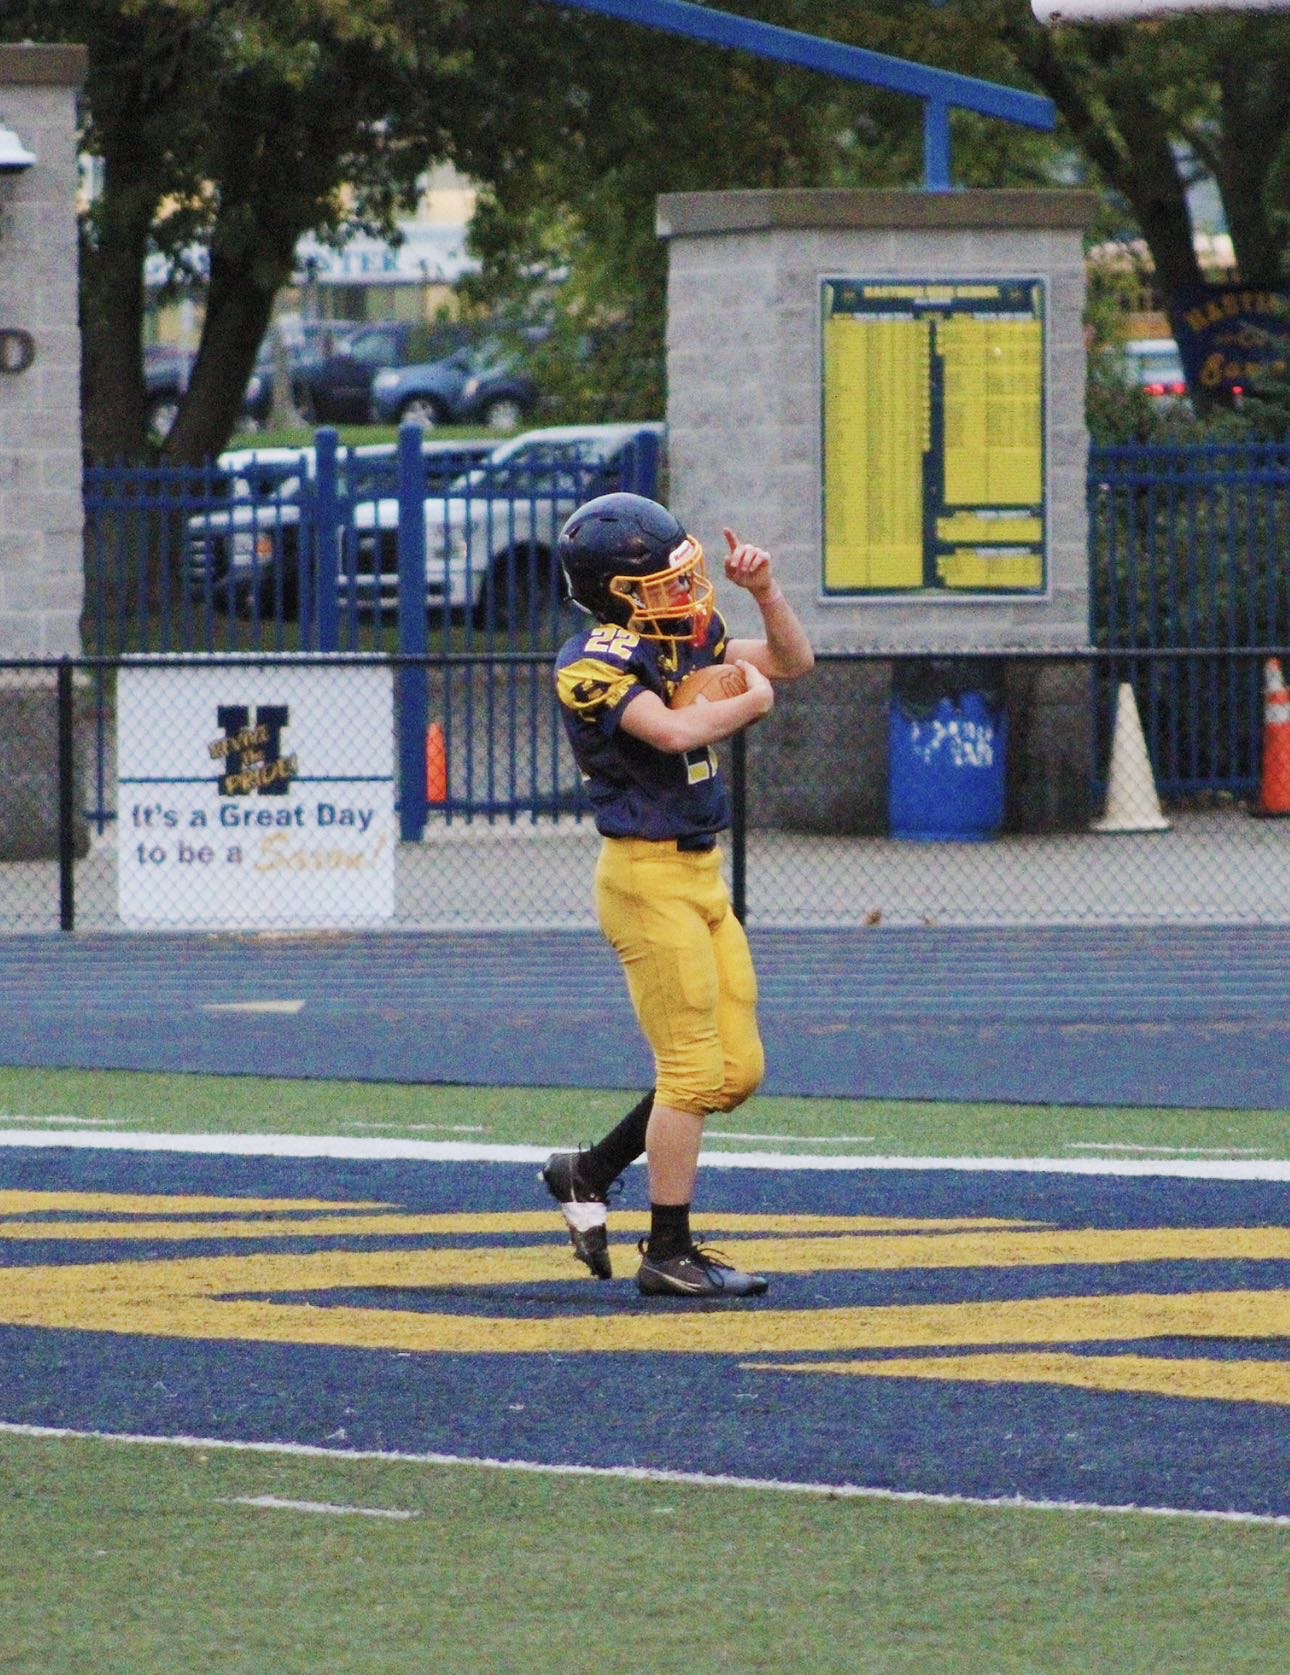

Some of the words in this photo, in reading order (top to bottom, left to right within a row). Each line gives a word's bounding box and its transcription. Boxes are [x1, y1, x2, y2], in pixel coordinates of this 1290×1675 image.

[584, 626, 641, 660] 22
[131, 803, 178, 828] It's
[189, 811, 208, 828] a
[219, 802, 305, 828] Great
[316, 802, 374, 833] Day
[136, 842, 167, 866] to
[178, 840, 215, 865] be
[226, 845, 243, 865] a
